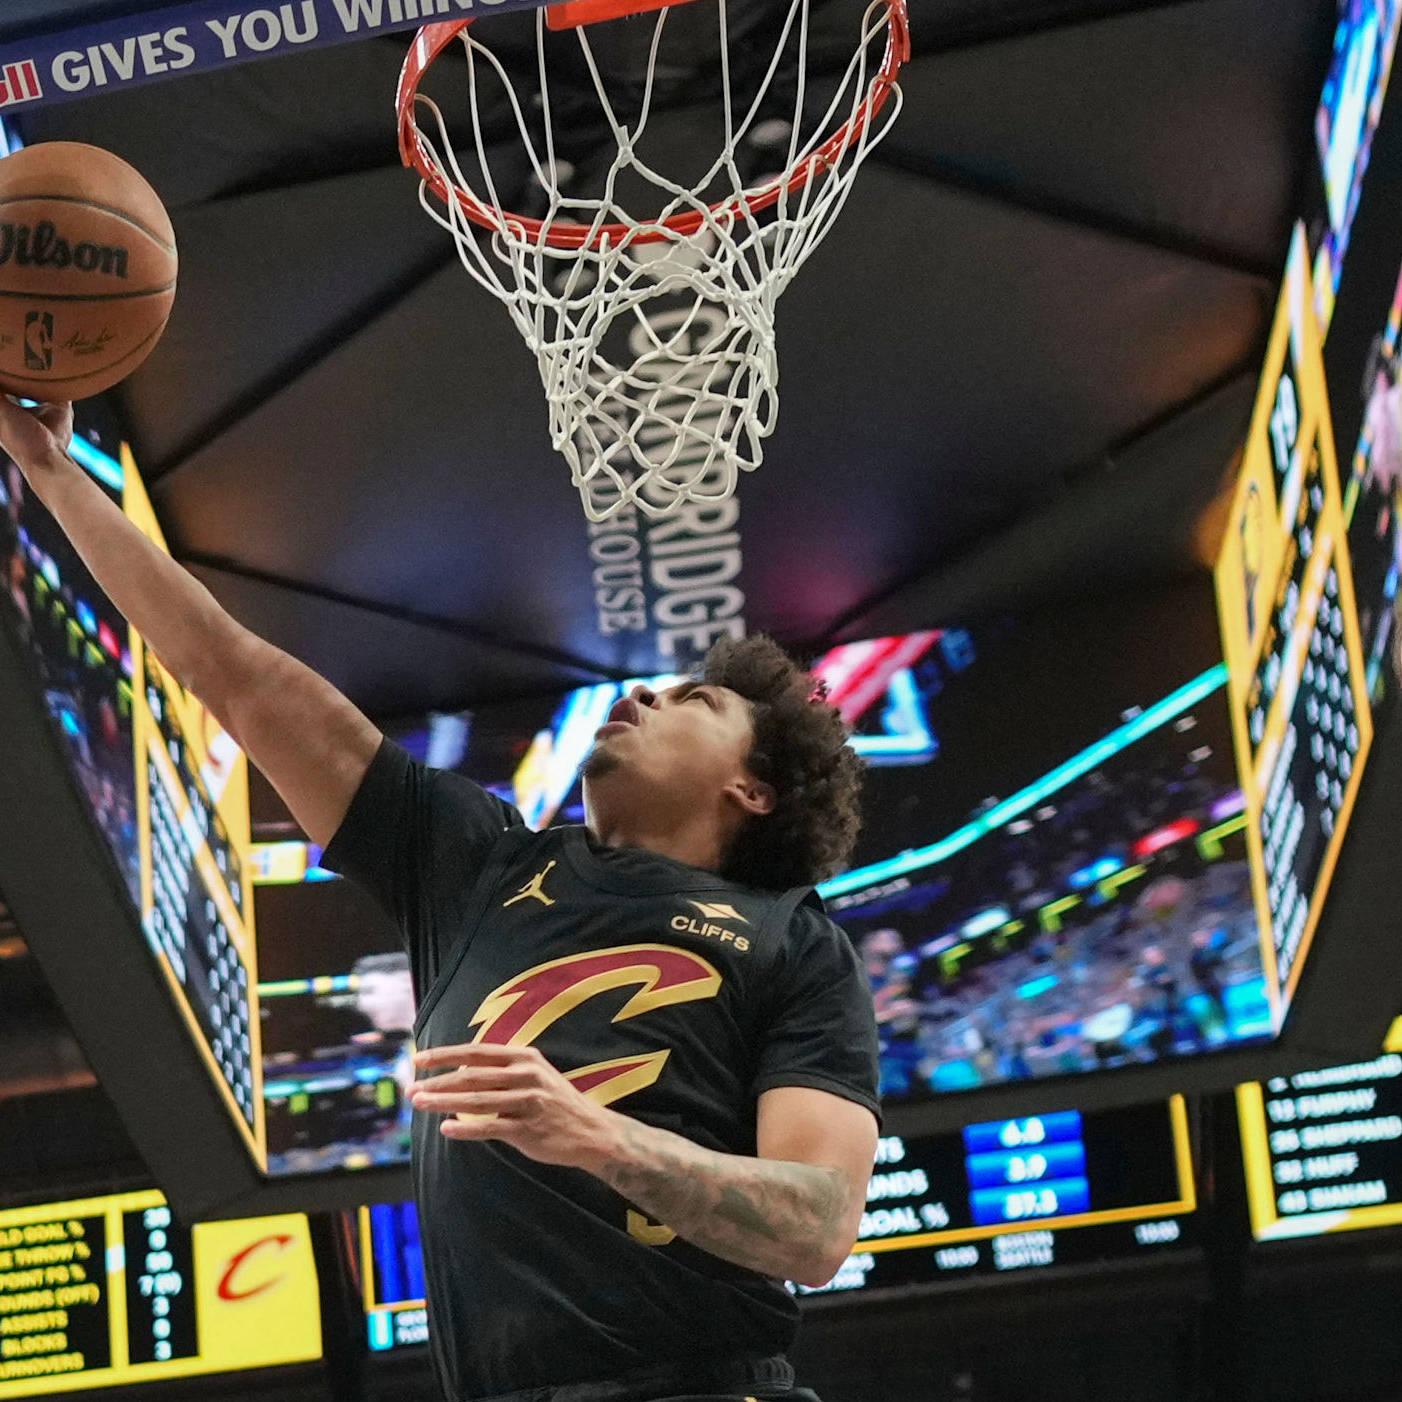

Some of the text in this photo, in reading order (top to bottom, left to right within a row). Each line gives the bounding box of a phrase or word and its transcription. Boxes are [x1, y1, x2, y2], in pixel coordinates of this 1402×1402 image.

[51, 26, 196, 94] GIVES
[206, 0, 322, 60] YOU
[670, 914, 751, 953] CLIFFS
